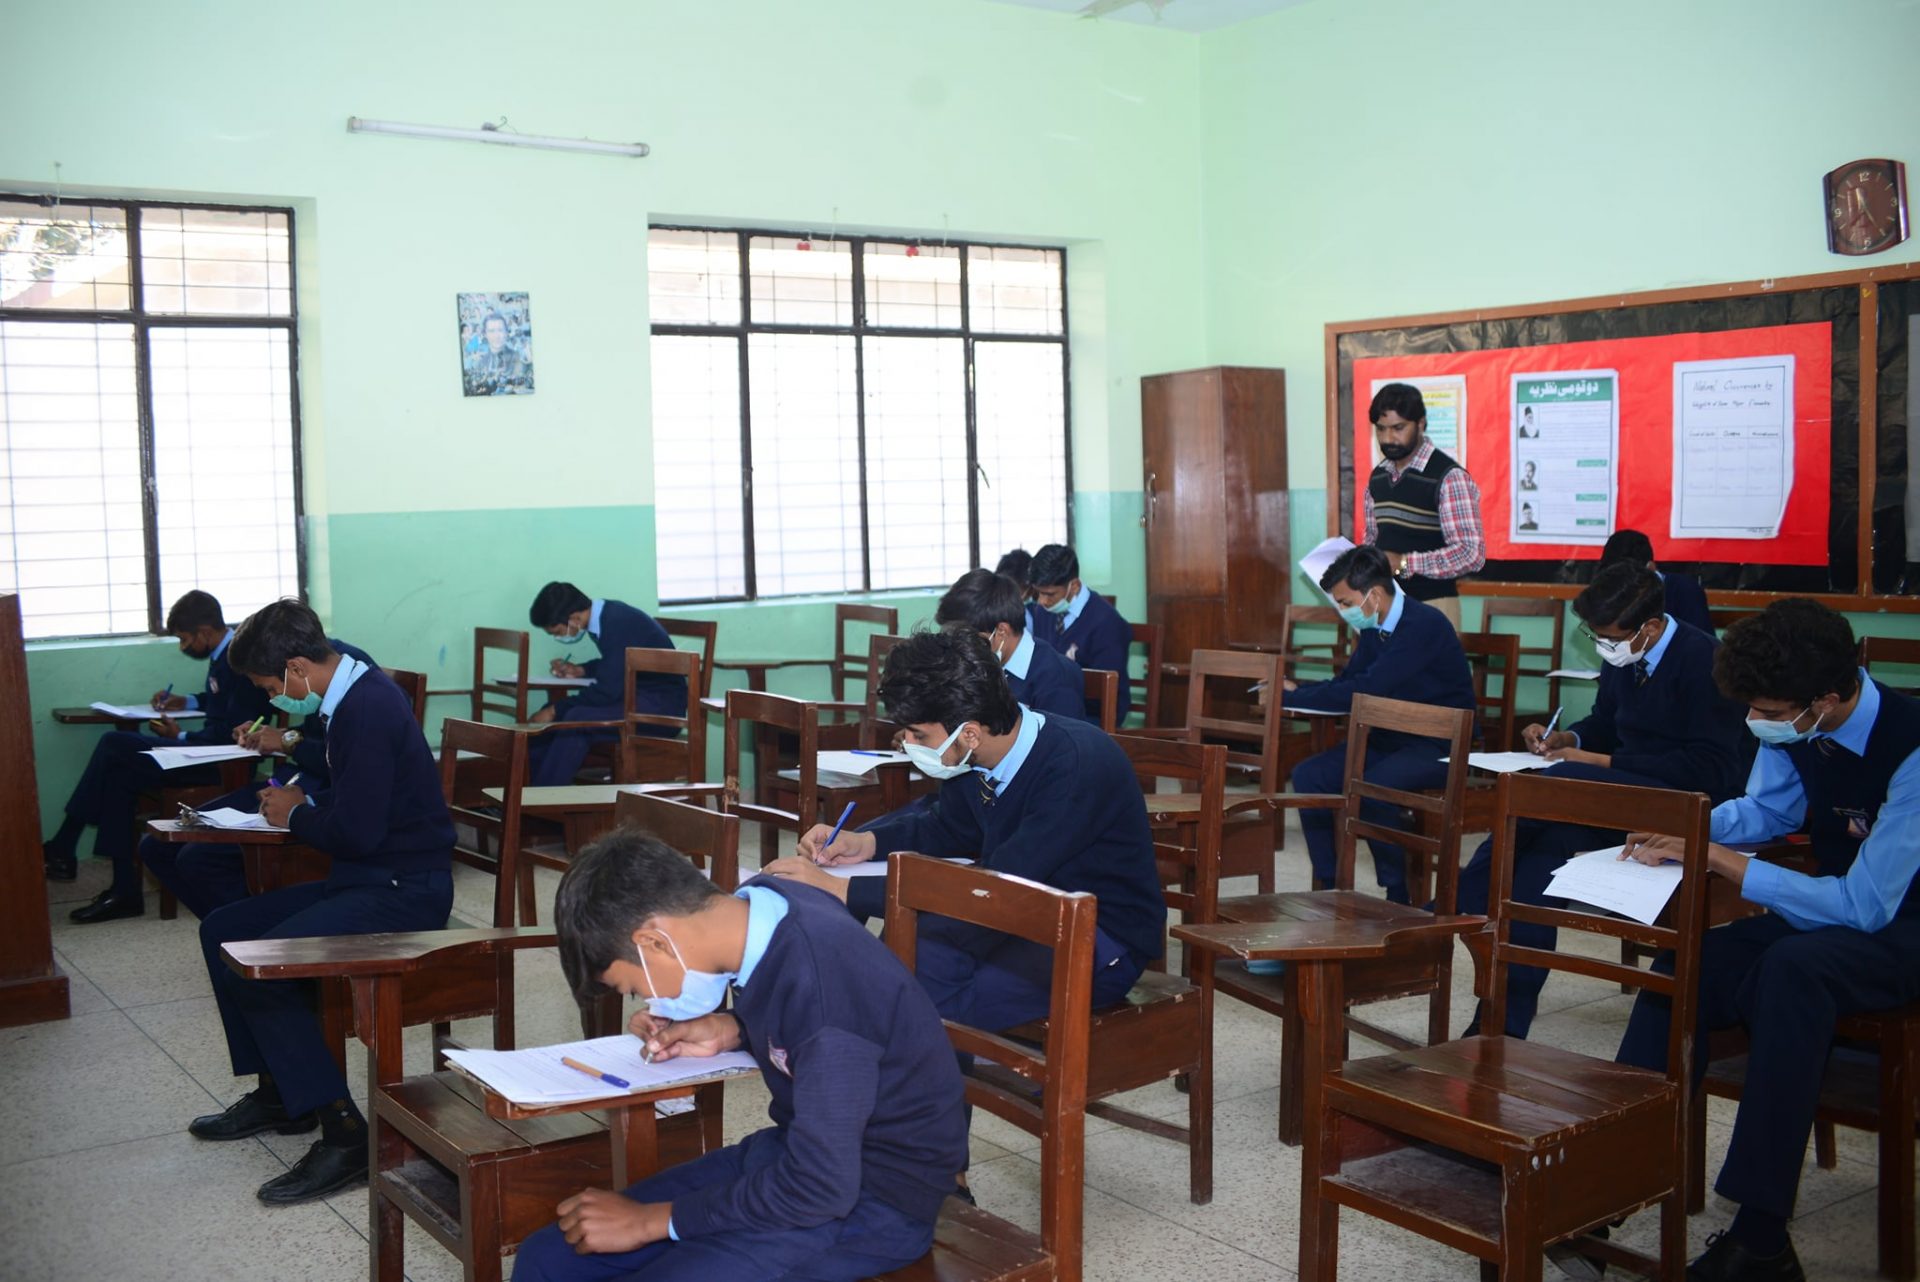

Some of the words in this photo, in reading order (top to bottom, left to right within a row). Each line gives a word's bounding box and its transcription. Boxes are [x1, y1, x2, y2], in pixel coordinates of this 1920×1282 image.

[1860, 172, 1870, 182] 12
[1890, 197, 1898, 207] 3
[1834, 208, 1842, 217] 9
[1863, 238, 1871, 250] 6
